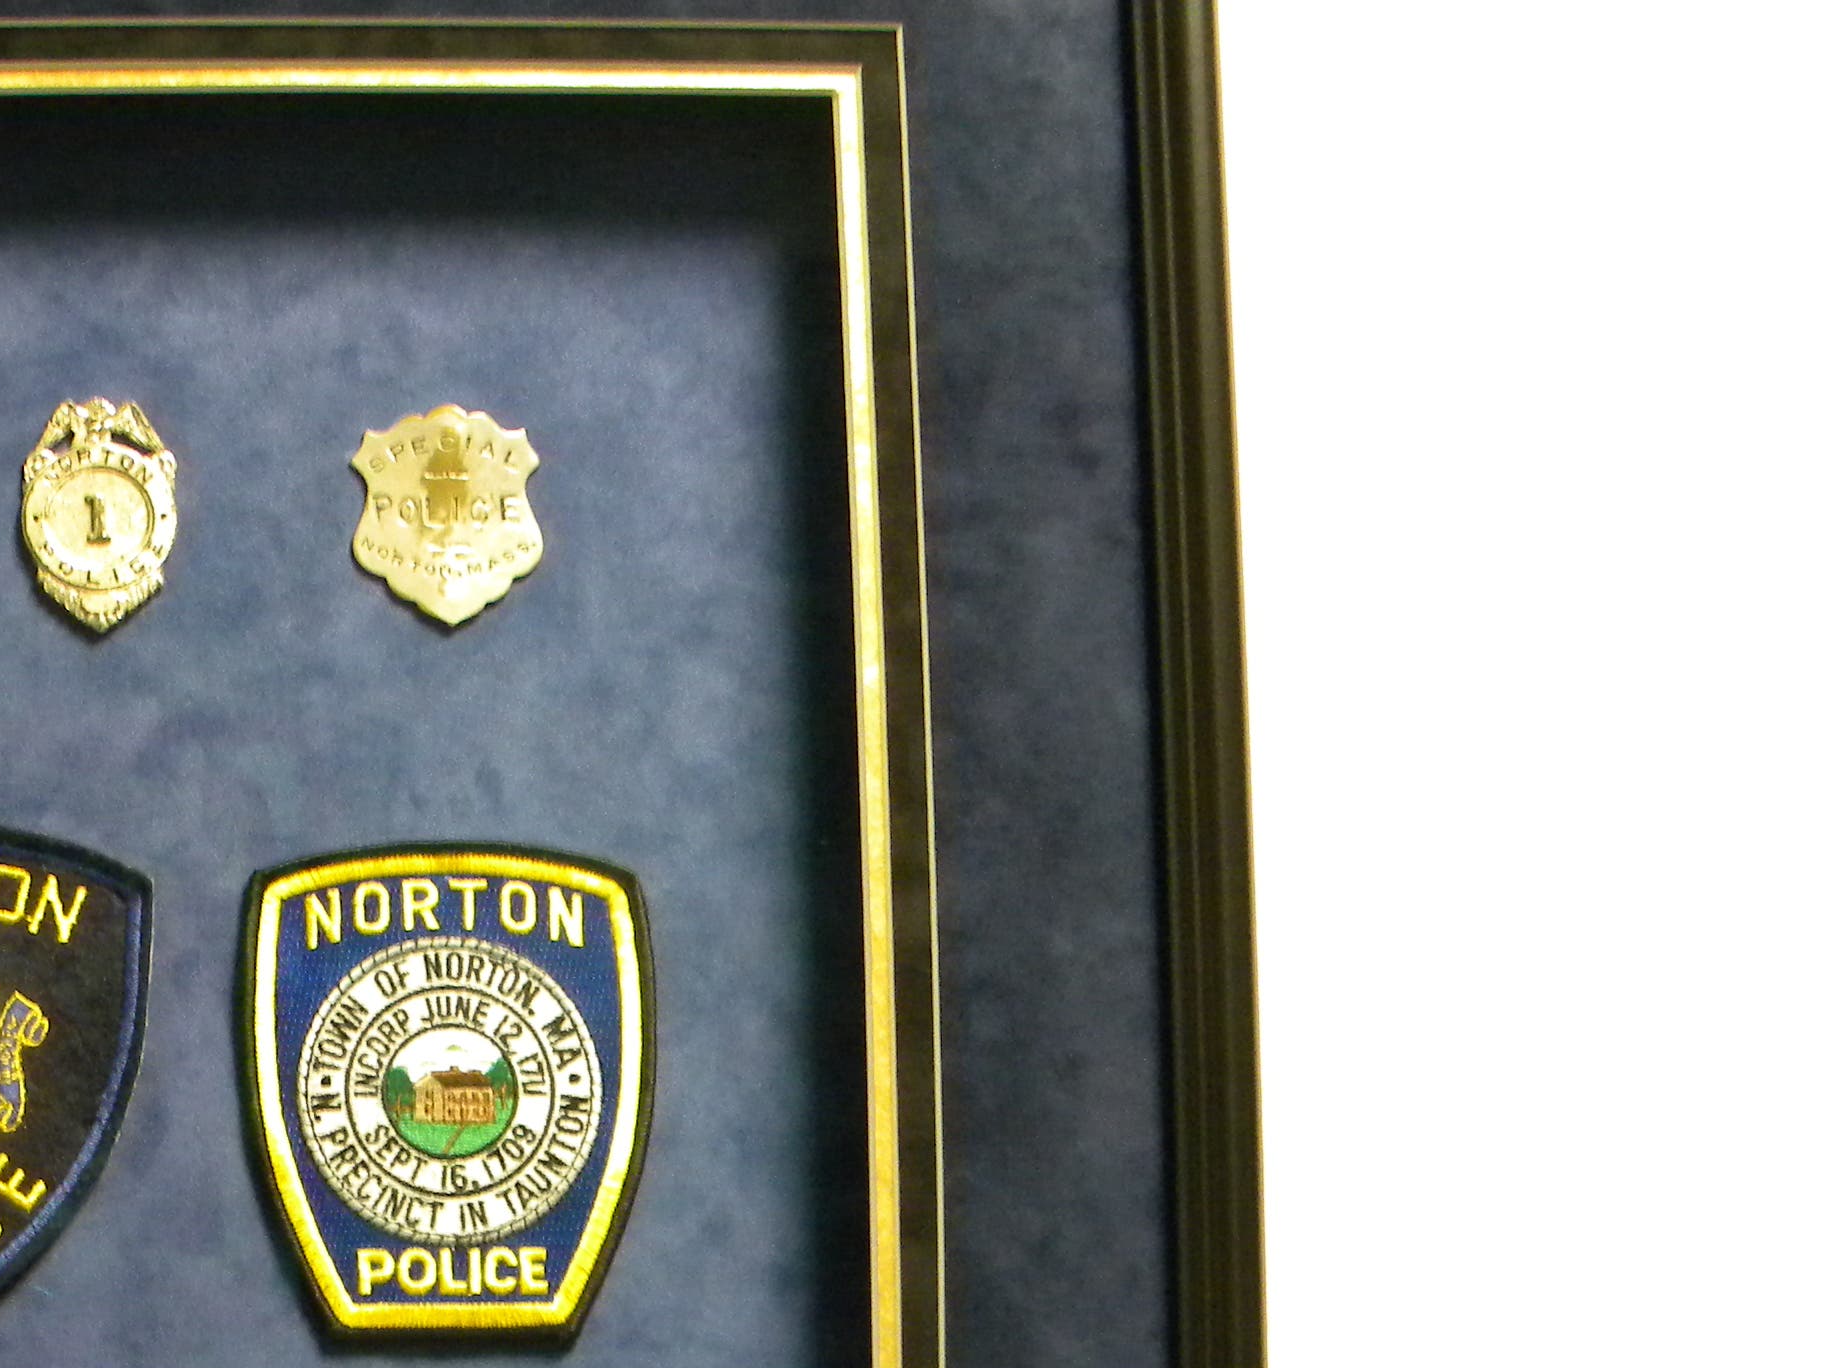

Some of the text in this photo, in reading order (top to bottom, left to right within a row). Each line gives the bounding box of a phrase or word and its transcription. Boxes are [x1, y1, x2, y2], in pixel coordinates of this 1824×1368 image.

[44, 448, 154, 484] NORTON
[367, 434, 521, 475] SPECIAL
[84, 494, 112, 545] 1
[372, 494, 522, 529] POLICE
[40, 543, 165, 587] POLICE
[303, 878, 585, 950] NORTON
[313, 995, 370, 1073] TOWN
[374, 960, 411, 998] OF
[541, 1015, 583, 1070] MA
[354, 1009, 412, 1098] INCORP
[420, 995, 492, 1029] JUNE
[318, 1127, 445, 1230] PRECINCT
[458, 1200, 490, 1231] IN
[495, 1093, 591, 1217] TAUNTON
[365, 1123, 430, 1183] SEPT
[354, 1247, 551, 1297] POLICE
